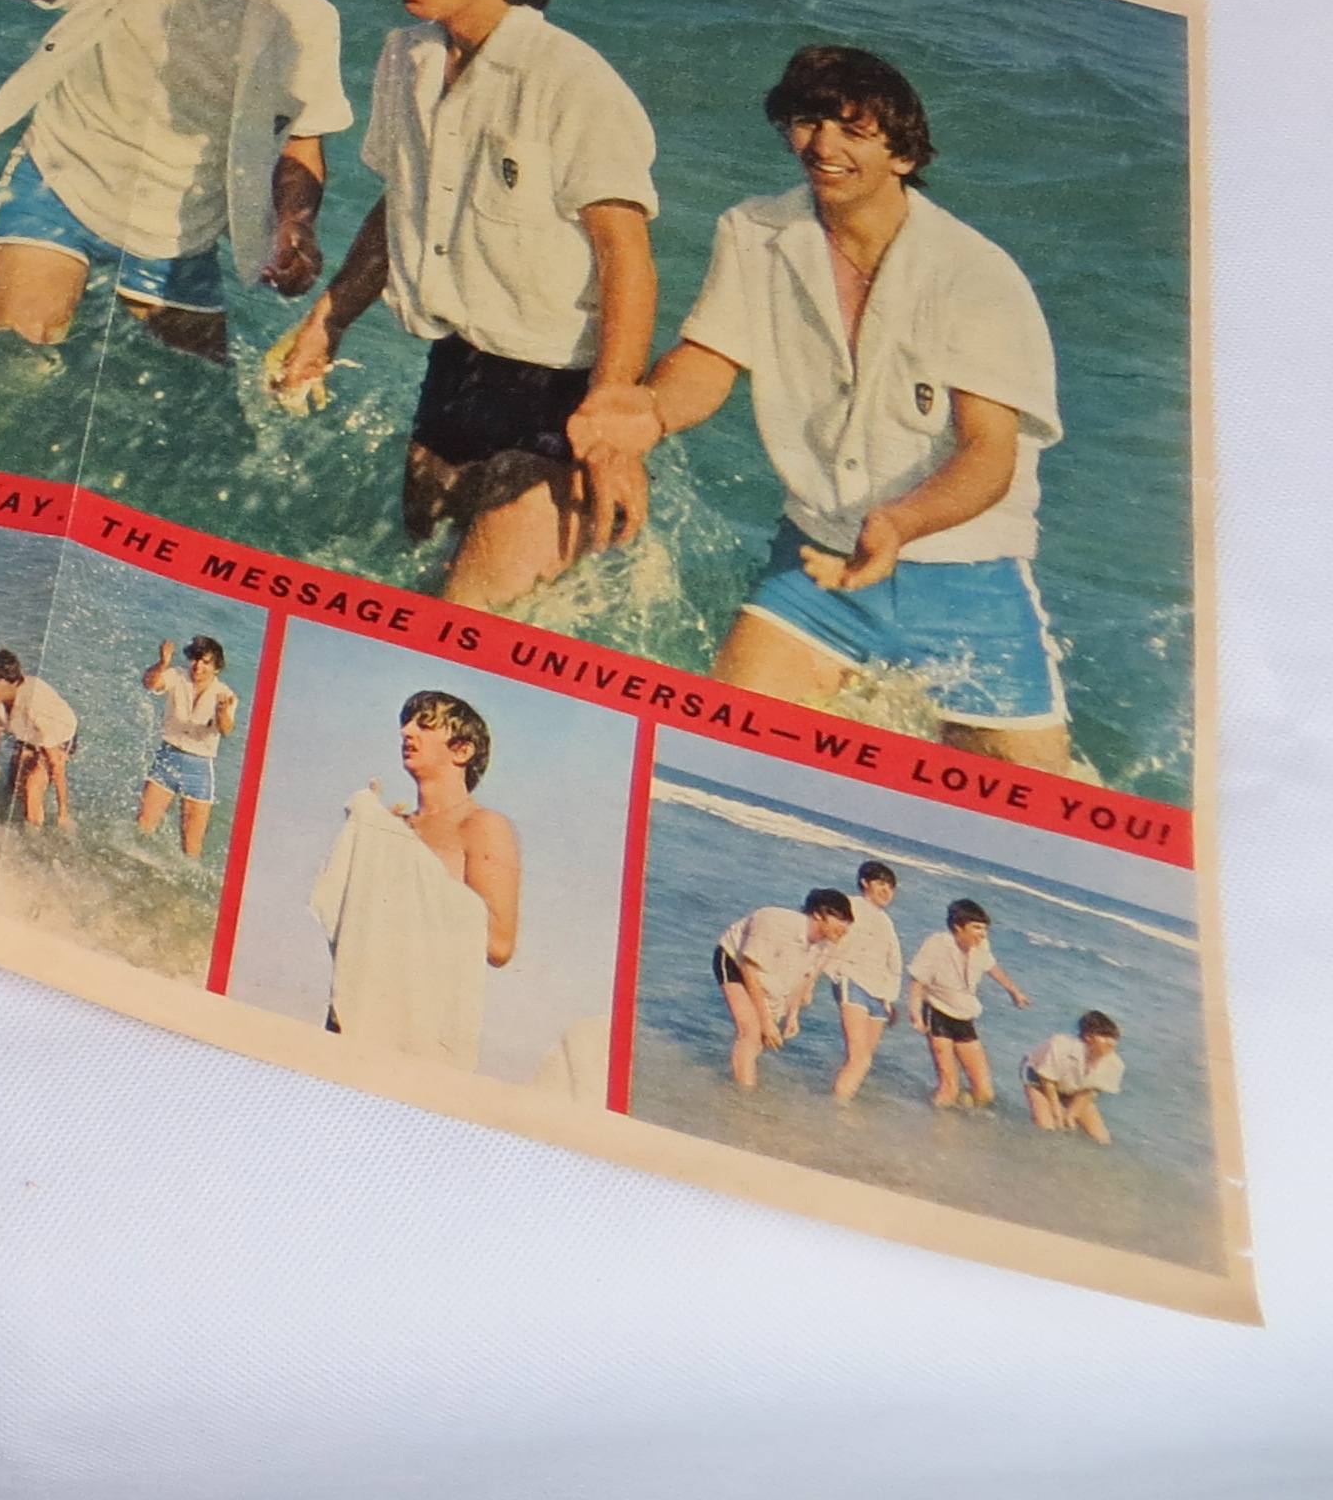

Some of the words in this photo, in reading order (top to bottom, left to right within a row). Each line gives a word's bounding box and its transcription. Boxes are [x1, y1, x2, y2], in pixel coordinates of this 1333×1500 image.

[100, 515, 181, 564] THE
[200, 553, 416, 633] MESSAGE
[437, 621, 482, 651] IS
[912, 758, 1034, 810] LOVE
[1059, 796, 1172, 847] YOU!
